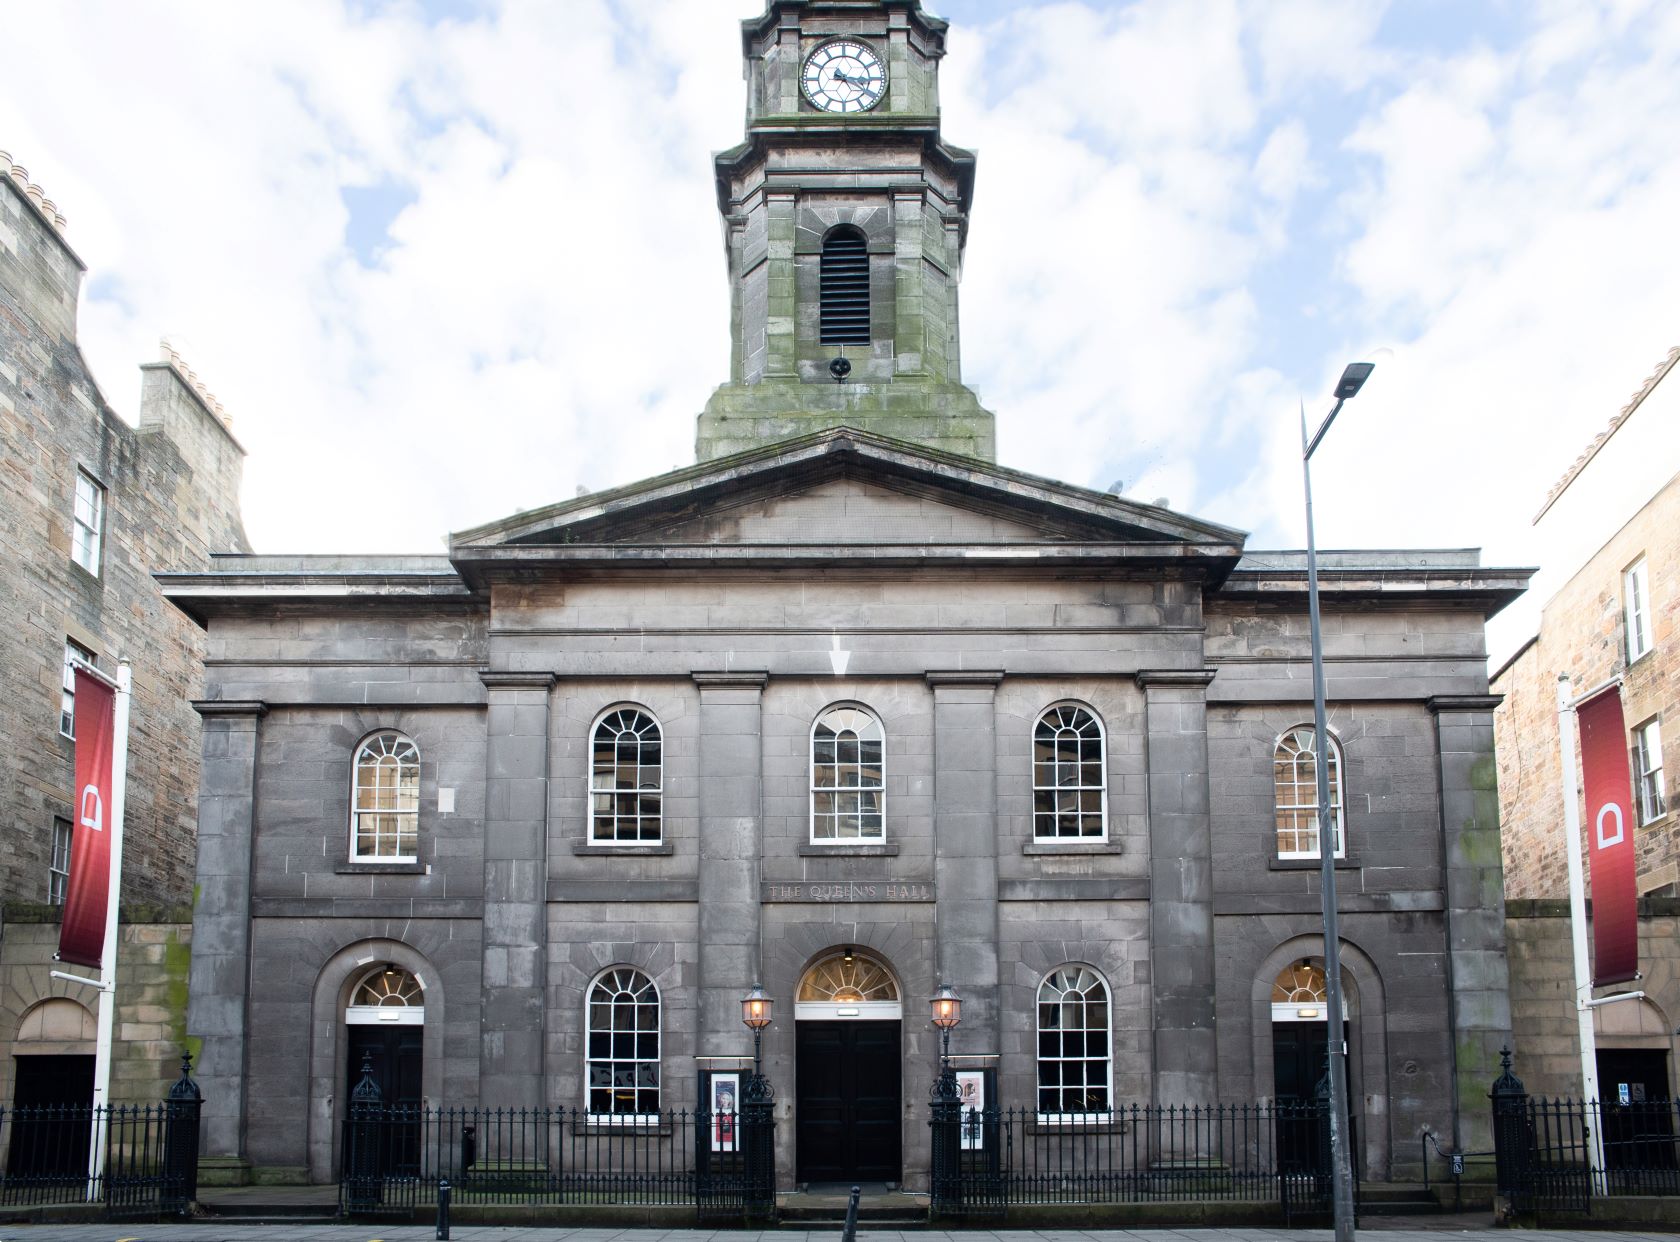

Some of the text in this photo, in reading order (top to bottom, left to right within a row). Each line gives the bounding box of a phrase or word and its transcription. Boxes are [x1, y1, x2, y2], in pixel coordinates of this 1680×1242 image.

[769, 885, 930, 898] THE QUEEN'S HALL
